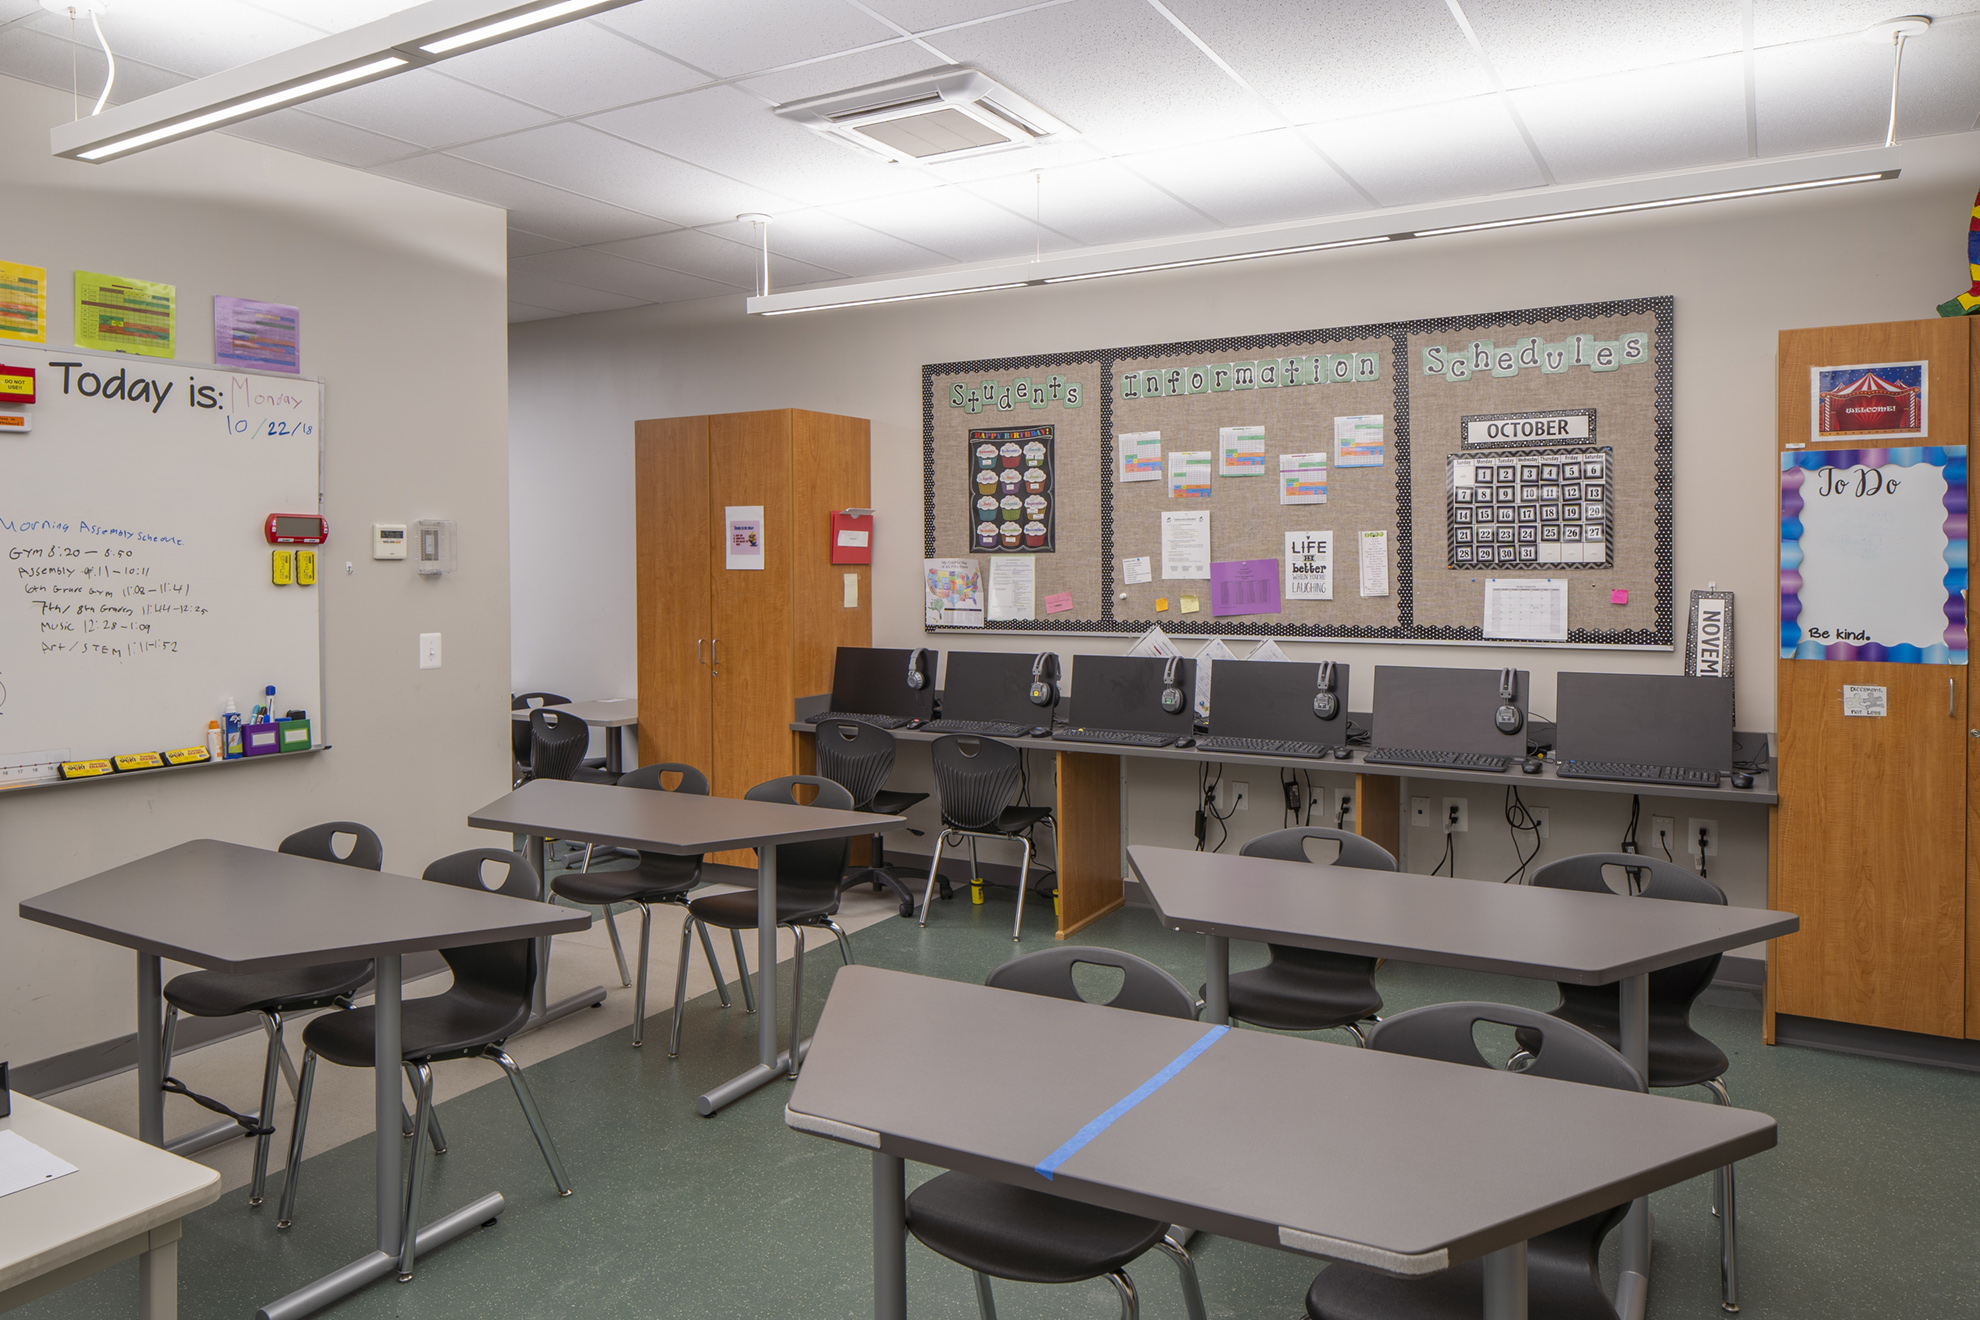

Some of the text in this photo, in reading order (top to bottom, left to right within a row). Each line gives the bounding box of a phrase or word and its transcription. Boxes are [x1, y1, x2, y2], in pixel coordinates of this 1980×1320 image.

[1124, 358, 1375, 398] Information
[48, 362, 224, 414] Today is:
[952, 376, 1078, 412] Students
[232, 376, 302, 414] Monday
[226, 415, 313, 440] 10/22/18
[1004, 428, 1050, 439] BIRTHDAY!
[1486, 419, 1570, 439] OCTOBER
[1818, 468, 1902, 498] To Do
[1526, 489, 1534, 497] 10
[1567, 488, 1576, 497] 12
[1590, 489, 1599, 497] 13
[1459, 512, 1468, 520] 14
[1501, 510, 1510, 518] 16
[1523, 510, 1532, 518] 17
[1545, 509, 1554, 517] 18
[1567, 508, 1576, 516] 19
[1590, 508, 1600, 516] 20
[80, 520, 134, 540] Assembly
[1460, 531, 1468, 540] 21
[1500, 531, 1511, 539] 23
[1523, 530, 1532, 538] 24
[1545, 528, 1556, 537] 25
[1567, 529, 1578, 537] 26
[1589, 528, 1600, 536] 27
[1292, 541, 1327, 553] LIFE
[1460, 549, 1532, 558] 28 29 30 31
[18, 566, 76, 579] Assembly
[1292, 563, 1327, 573] better
[1292, 582, 1326, 593] LAUGHING
[41, 622, 74, 632] Music
[1808, 627, 1871, 641] Be kind.
[1700, 611, 1721, 677] NOVEM
